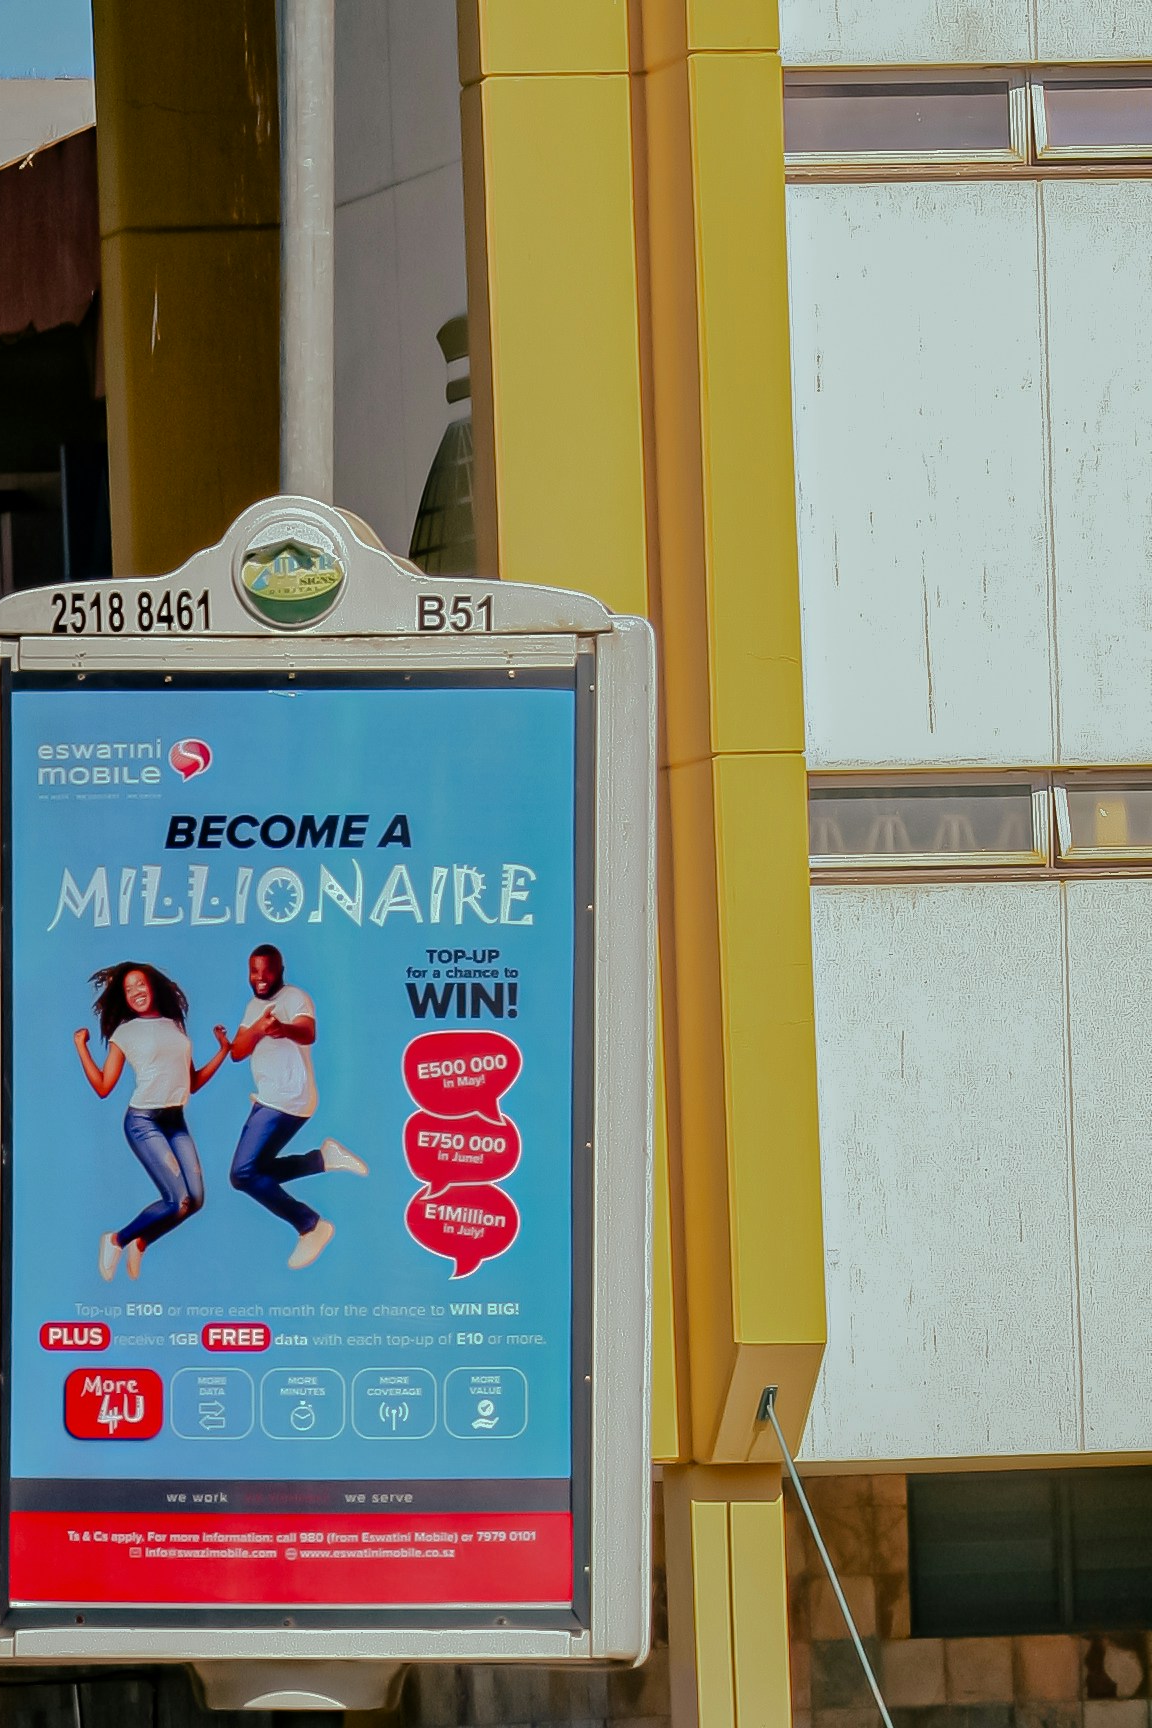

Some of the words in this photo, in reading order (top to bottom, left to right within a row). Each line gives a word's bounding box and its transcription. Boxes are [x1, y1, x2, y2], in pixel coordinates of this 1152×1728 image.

[51, 591, 125, 633] 2518
[138, 589, 210, 632] 8461
[416, 593, 493, 631] B51
[164, 813, 369, 850] BECOME
[376, 813, 412, 850] A
[47, 858, 538, 931] MILLIONAIRE
[425, 948, 501, 964] TOP-UP
[406, 966, 428, 978] for
[432, 968, 441, 979] a
[445, 966, 499, 979] chance
[504, 967, 519, 979] to
[405, 982, 518, 1018] WIN!
[416, 1058, 466, 1079] E500
[469, 1054, 508, 1073] 000
[457, 1074, 485, 1088] May!
[417, 1131, 465, 1150] E750
[468, 1135, 506, 1154] 000
[451, 1152, 484, 1164] June!
[424, 1203, 506, 1228] E1Million
[457, 1225, 485, 1240] July!
[74, 1303, 122, 1318] Top-up
[126, 1303, 163, 1317] E100
[168, 1306, 182, 1317] or
[186, 1306, 224, 1317] more
[228, 1304, 264, 1317] each
[268, 1303, 315, 1317] month
[319, 1303, 340, 1317] for
[344, 1303, 368, 1317] the
[372, 1303, 426, 1317] chance
[431, 1304, 445, 1317] to
[449, 1303, 482, 1316] WIN
[487, 1303, 520, 1316] BIG!
[48, 1327, 103, 1346] PLUS
[114, 1333, 165, 1346] receive
[169, 1333, 198, 1346] 1GB
[208, 1328, 264, 1346] FREE
[275, 1333, 308, 1346] data
[312, 1333, 342, 1346] with
[346, 1333, 382, 1346] each
[386, 1333, 434, 1349] top-up
[438, 1332, 452, 1346] of
[457, 1332, 483, 1346] E10
[488, 1335, 502, 1346] or
[506, 1335, 547, 1346] more.
[81, 1375, 139, 1397] More
[287, 1376, 317, 1385] MORE
[379, 1376, 409, 1385] MORE
[471, 1375, 501, 1384] MORE
[199, 1387, 226, 1396] DATA
[280, 1387, 326, 1396] MINUTES
[366, 1387, 422, 1396] COVERAGE
[469, 1386, 502, 1395] VALUE
[166, 1493, 186, 1503] we
[192, 1491, 229, 1503] work
[344, 1493, 365, 1503] we
[371, 1493, 413, 1504] serve
[82, 1530, 91, 1542] &
[111, 1532, 145, 1544] apply.
[148, 1531, 166, 1543] For
[170, 1533, 199, 1543] more
[276, 1531, 297, 1543] call
[327, 1531, 359, 1544] (from
[361, 1531, 411, 1543] Eswatini
[414, 1531, 458, 1544] Mobile)
[461, 1533, 473, 1543] or
[477, 1531, 506, 1542] 7979
[509, 1530, 537, 1542] 0101
